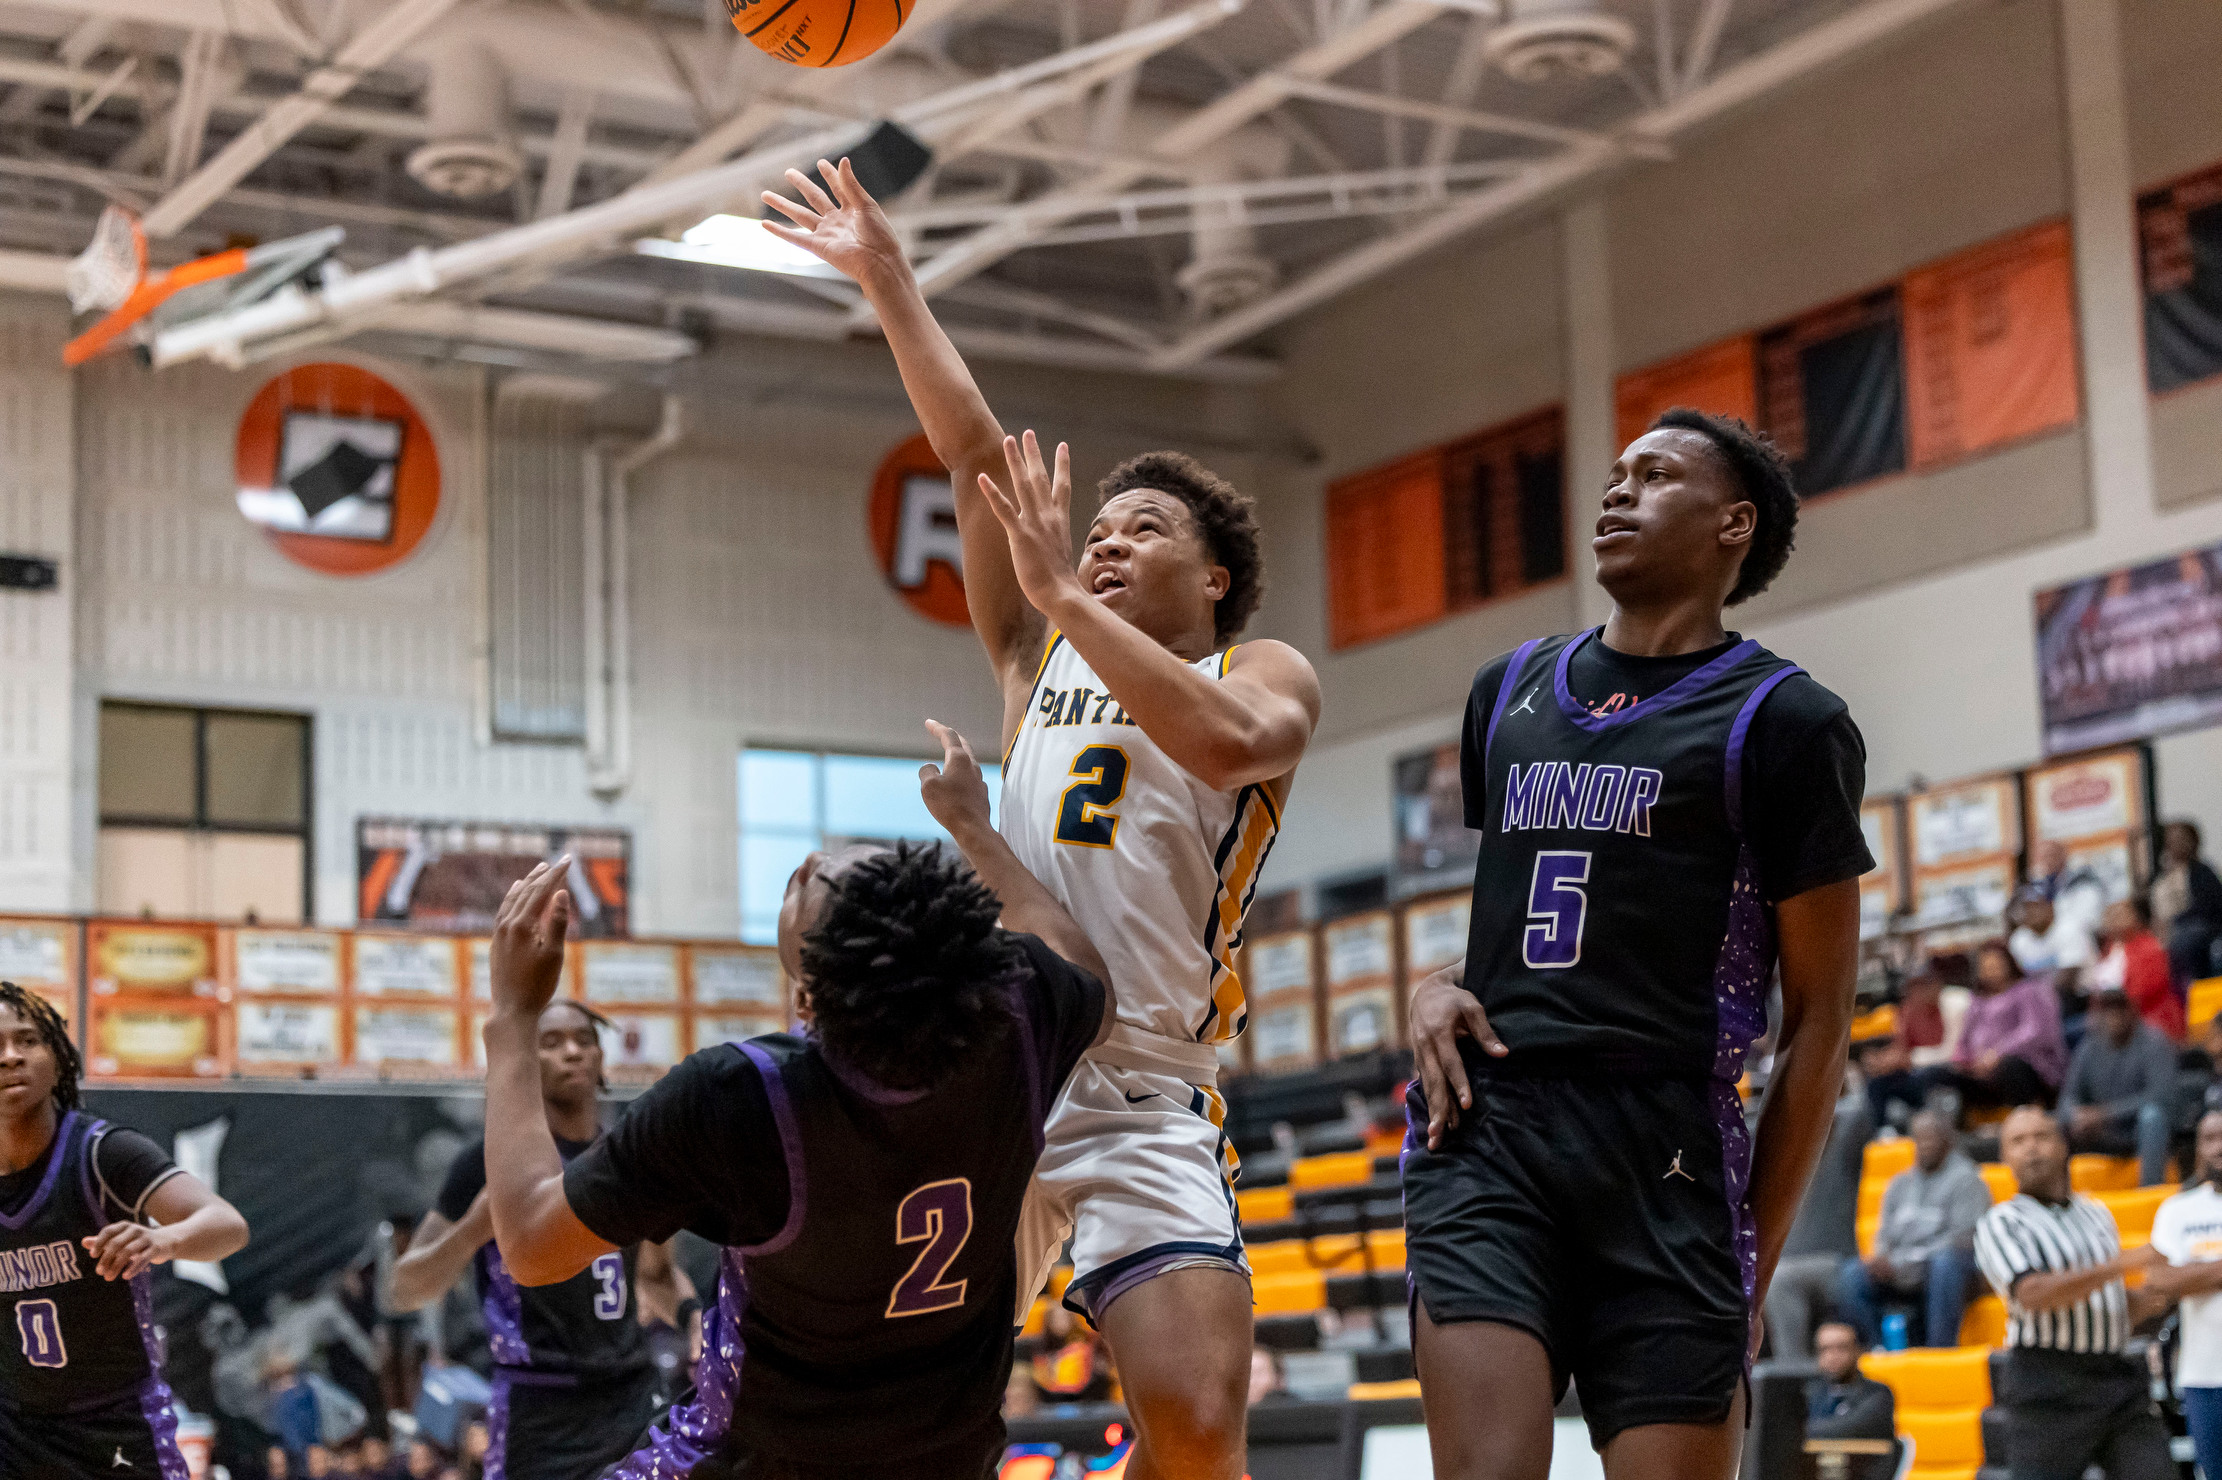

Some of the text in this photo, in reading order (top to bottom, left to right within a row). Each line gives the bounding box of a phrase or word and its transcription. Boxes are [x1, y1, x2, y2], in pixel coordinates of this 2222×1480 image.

[767, 33, 811, 63] VO
[1053, 743, 1131, 850] 2
[1502, 762, 1663, 837] MINOR
[1522, 850, 1593, 969] 5
[0, 1240, 83, 1292] INOR
[885, 1176, 973, 1318] 2
[592, 1251, 627, 1320] 3
[15, 1298, 68, 1368] 0
